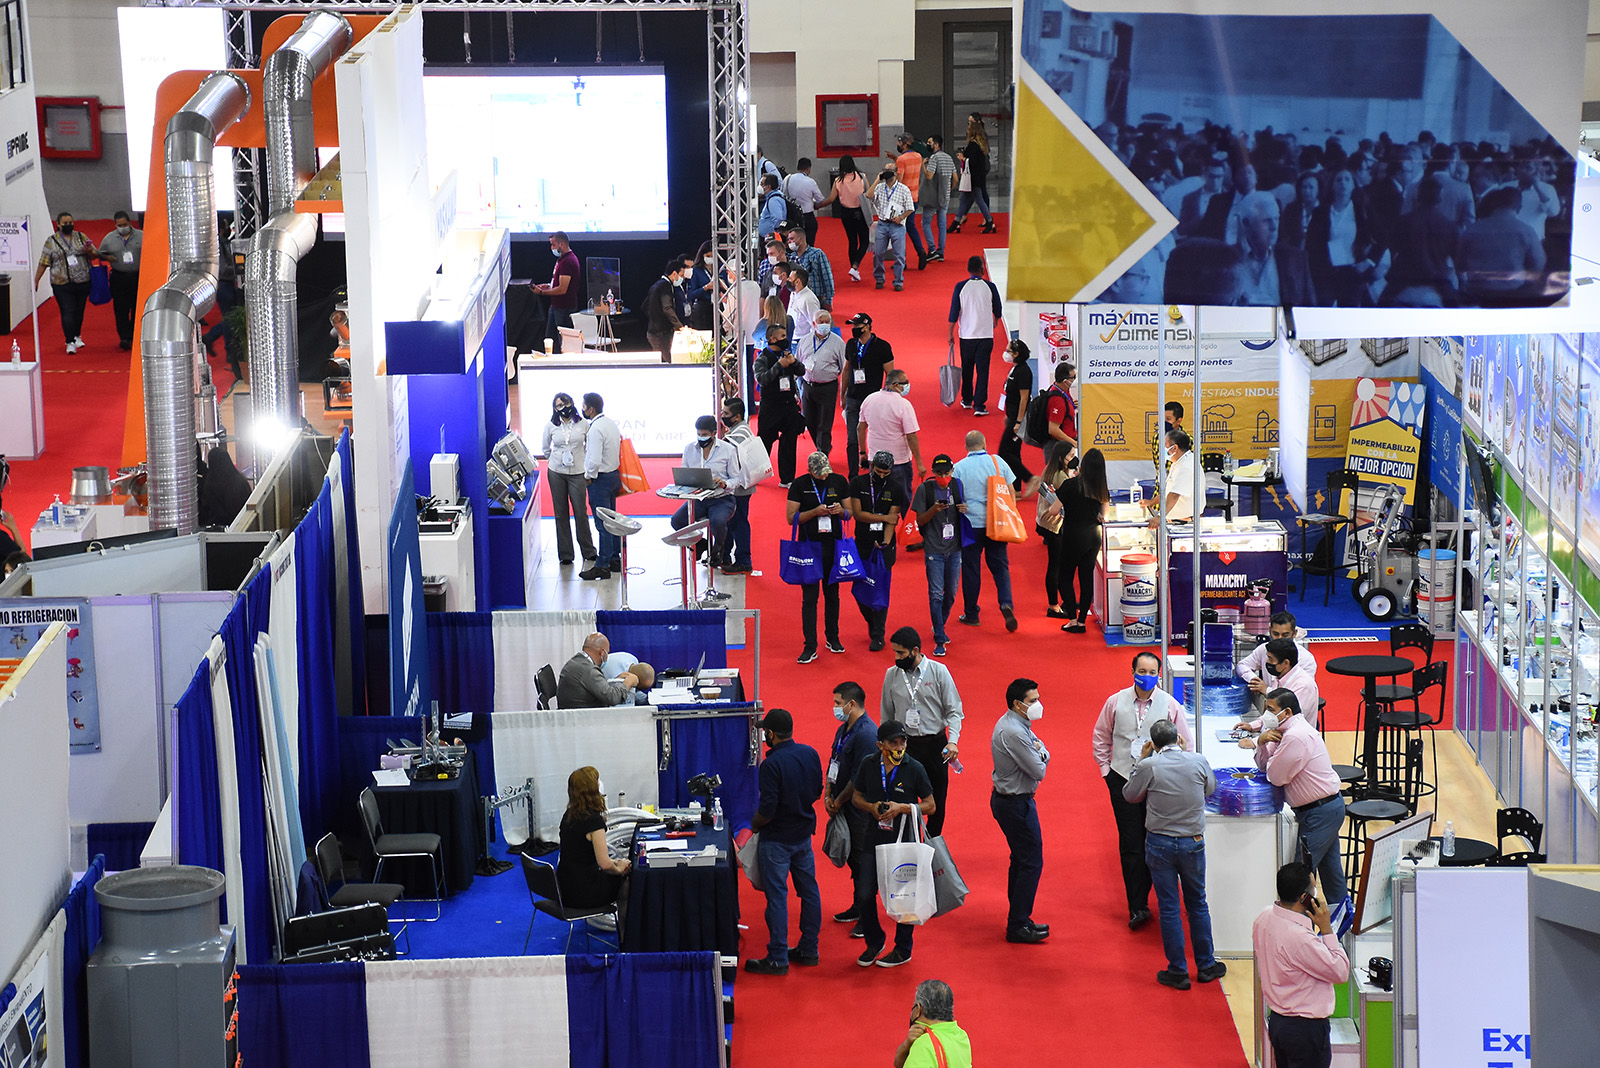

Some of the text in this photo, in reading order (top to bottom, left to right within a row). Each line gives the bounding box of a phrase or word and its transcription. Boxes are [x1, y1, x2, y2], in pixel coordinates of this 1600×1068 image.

[1089, 359, 1233, 369] Sistemas de do compnentes
[1088, 371, 1111, 379] para
[1183, 387, 1315, 398] NESTRAS INDUSS
[1352, 438, 1416, 453] IMPERMEABILIZA
[1367, 448, 1398, 459] CON LA
[1349, 456, 1414, 479] MEJOR OPCIÓN
[11, 608, 78, 624] REFRIGERACION
